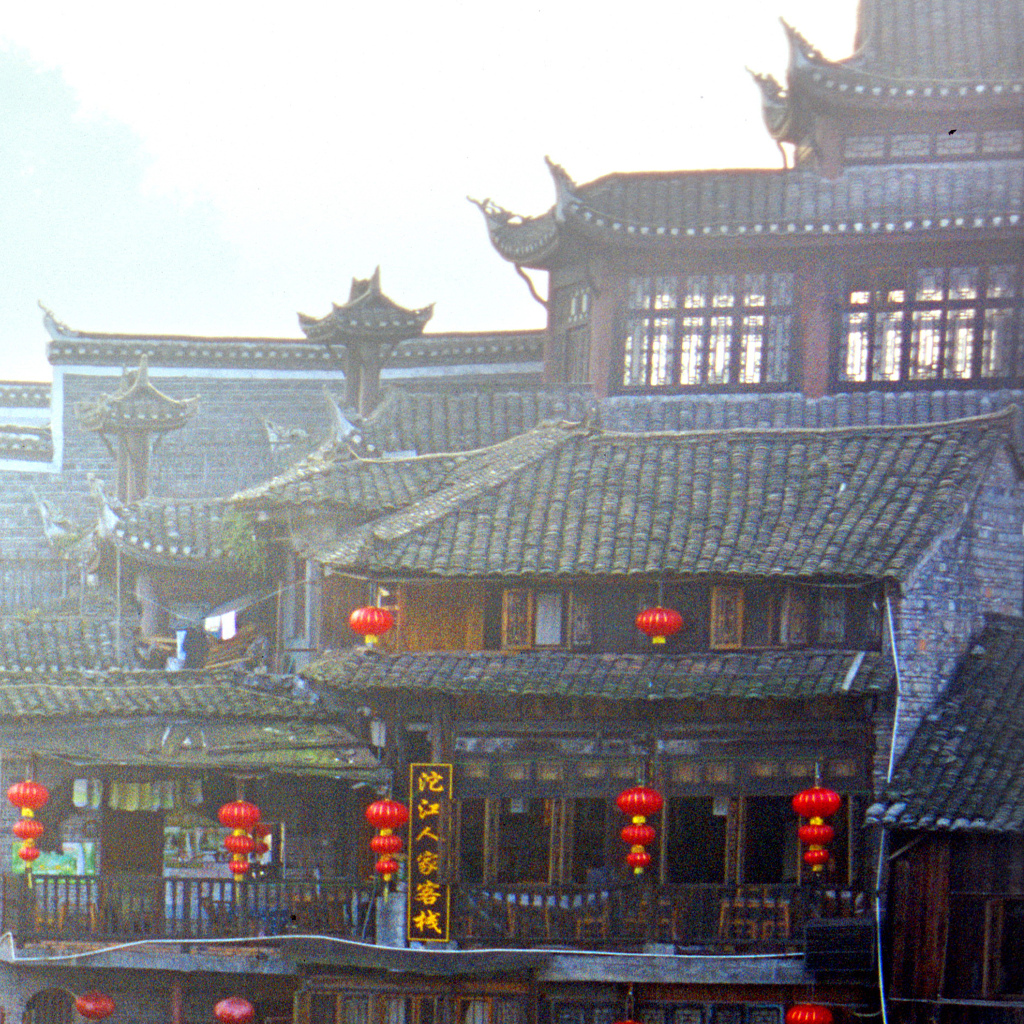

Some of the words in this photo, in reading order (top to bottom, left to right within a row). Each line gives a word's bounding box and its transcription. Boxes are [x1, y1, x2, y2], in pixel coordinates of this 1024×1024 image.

[413, 770, 444, 935] 沱江人家客栈
